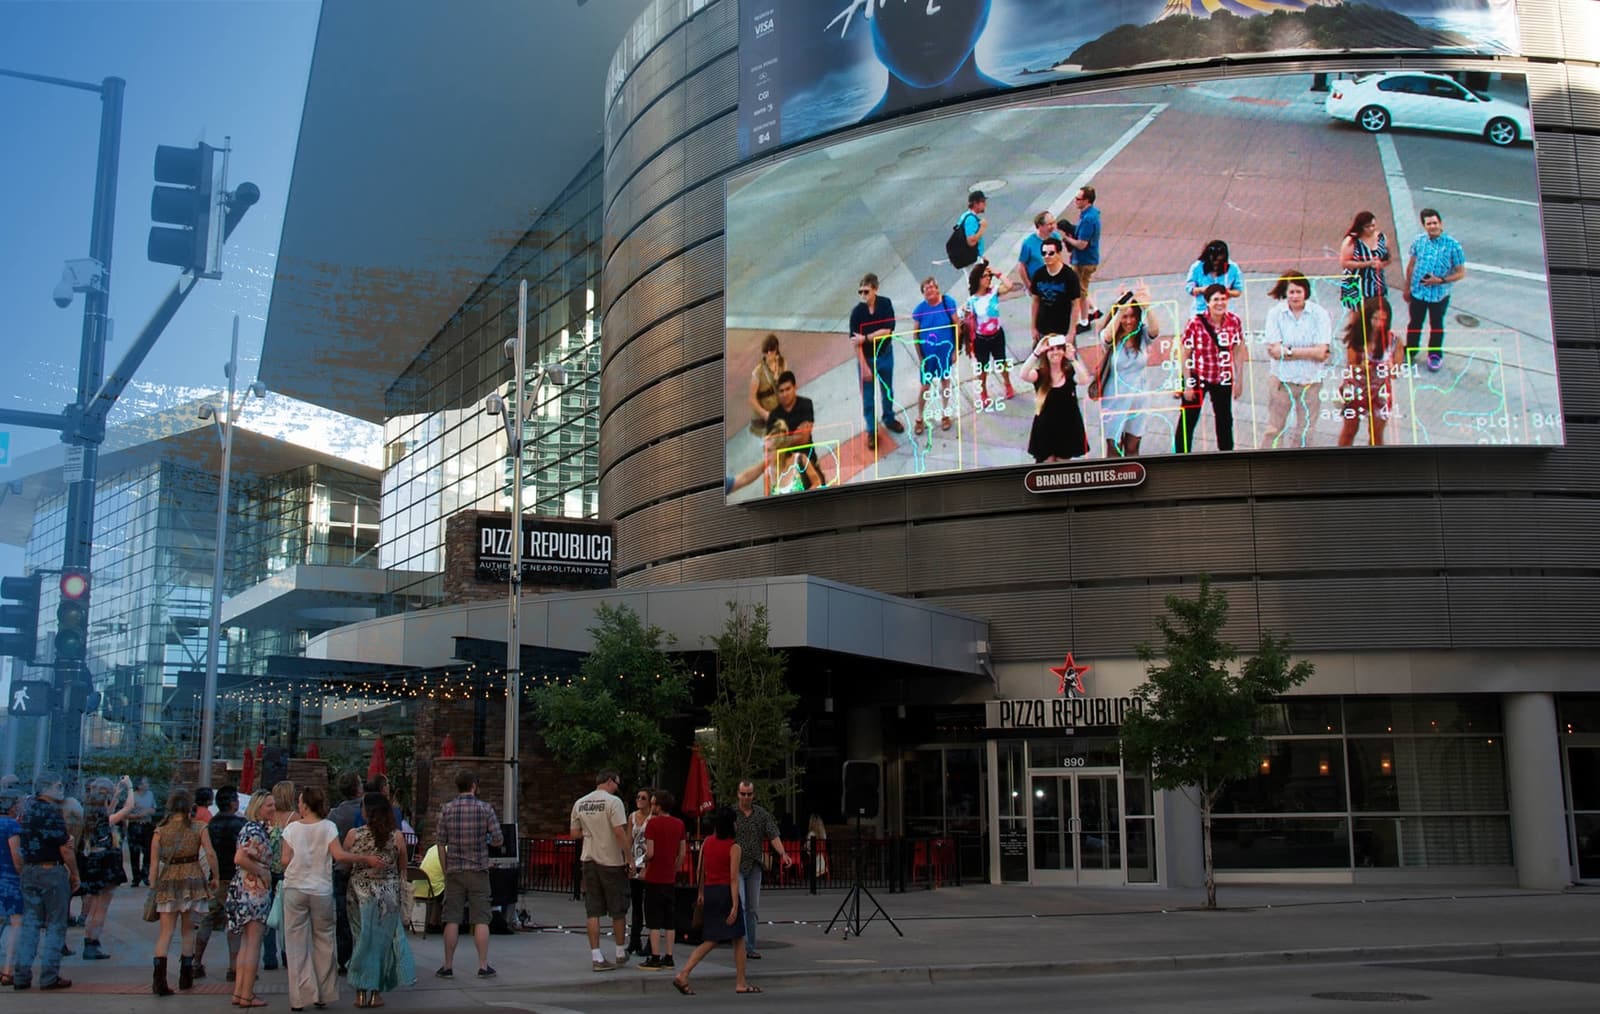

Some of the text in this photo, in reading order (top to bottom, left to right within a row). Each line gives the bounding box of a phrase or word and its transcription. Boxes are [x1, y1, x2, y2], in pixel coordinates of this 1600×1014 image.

[754, 18, 775, 35] VISA
[1219, 351, 1231, 367] 2
[1220, 371, 1232, 386] 2
[1378, 384, 1391, 399] 4
[974, 397, 1006, 414] 926
[1036, 469, 1137, 487] BRANDED CITIES.com
[531, 530, 612, 561] REPUBLICA
[479, 561, 528, 570] AUTHEC
[530, 564, 583, 574] NEAPOLITAN
[1000, 699, 1045, 727] PIZZA
[1063, 757, 1085, 767] 890
